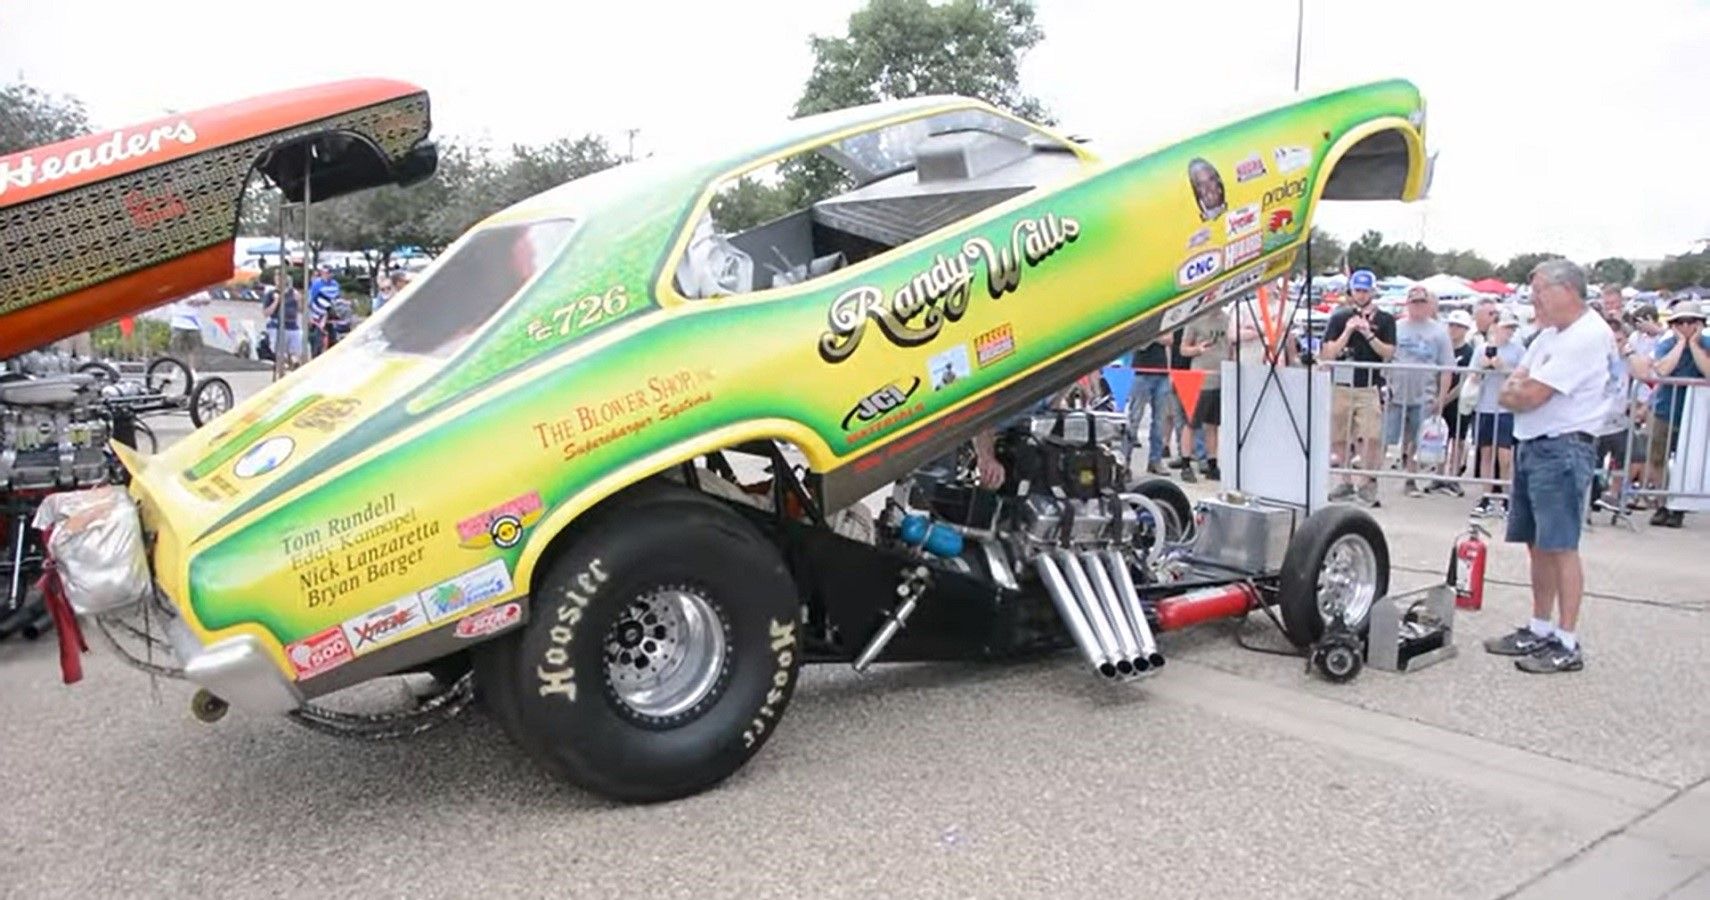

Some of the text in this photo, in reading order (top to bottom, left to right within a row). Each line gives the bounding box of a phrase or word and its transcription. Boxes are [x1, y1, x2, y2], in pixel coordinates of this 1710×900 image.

[819, 252, 975, 363] Randy
[961, 212, 1081, 299] Walls
[1186, 256, 1215, 280] CNC
[554, 285, 628, 335] 726
[281, 493, 397, 556] Tom Rundell
[299, 519, 441, 591] Nick Lanzaretta
[307, 545, 426, 609] Bryan Barger
